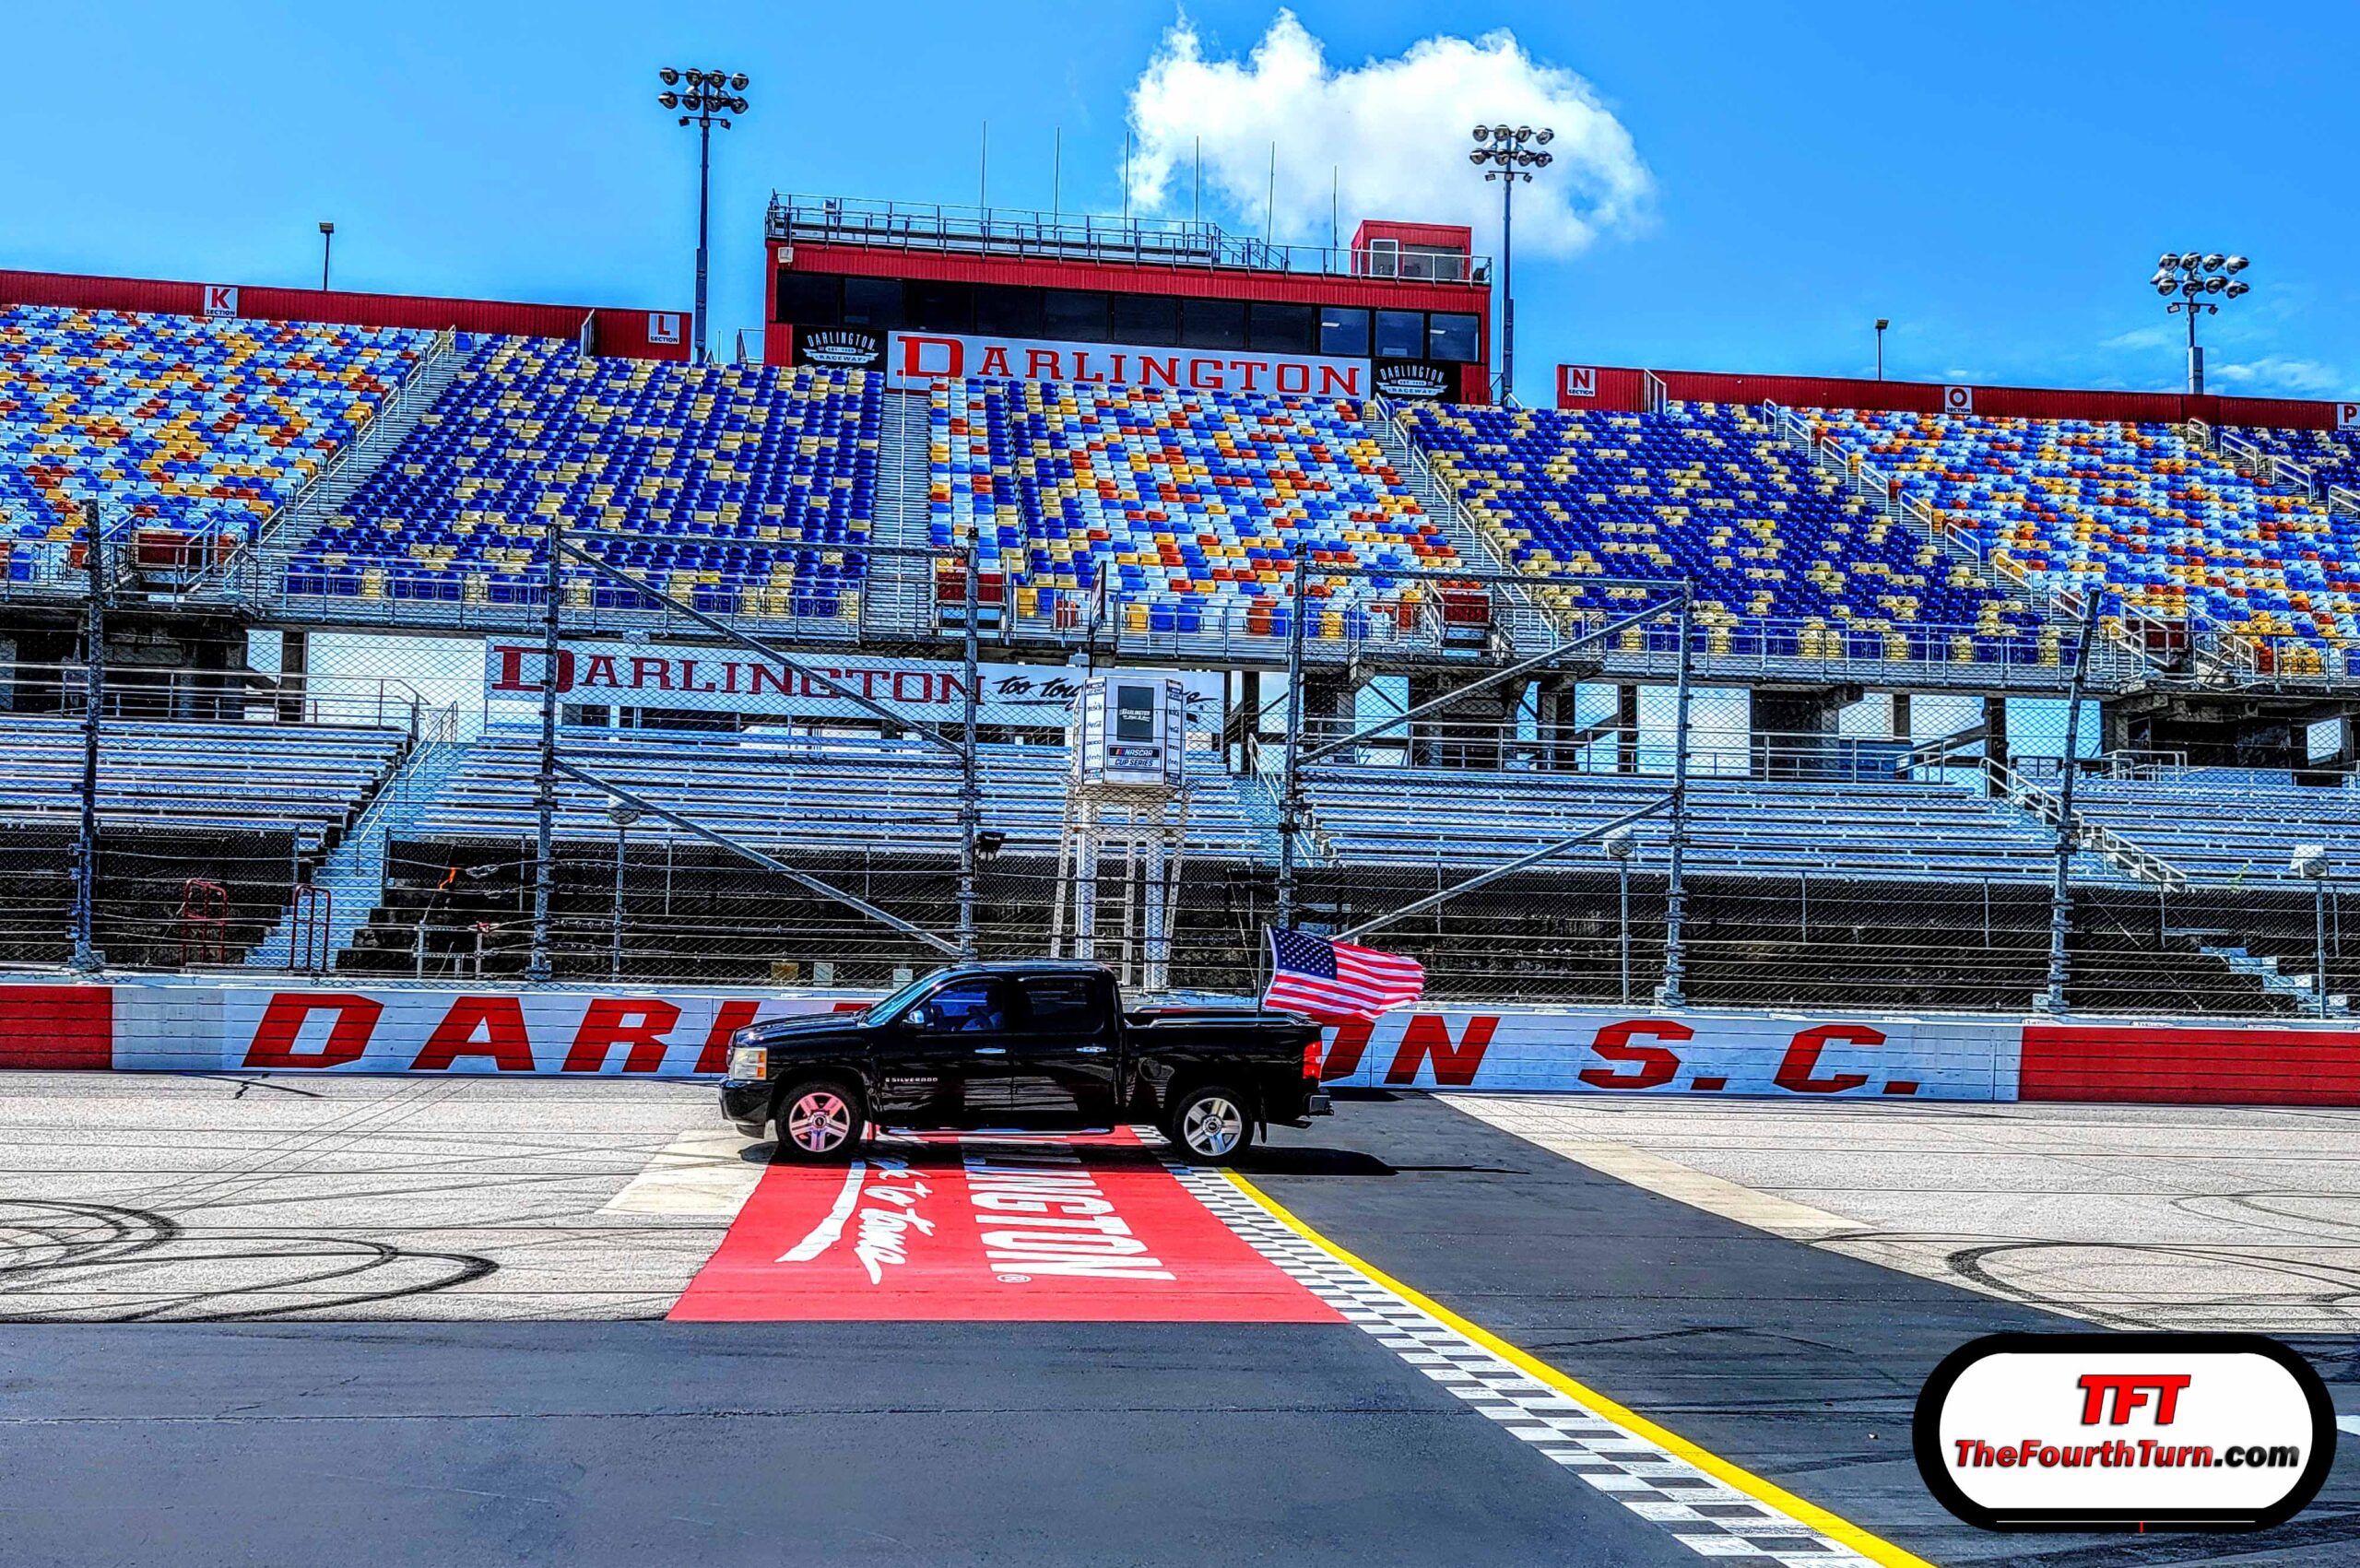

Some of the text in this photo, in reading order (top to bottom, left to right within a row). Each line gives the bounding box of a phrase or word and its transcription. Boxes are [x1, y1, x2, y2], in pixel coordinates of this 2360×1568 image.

[211, 288, 231, 309] K
[657, 314, 671, 336] L
[807, 331, 877, 351] DARLINGTON
[819, 354, 863, 362] RACEWAY
[896, 335, 1361, 396] DARLINGTON
[1379, 365, 1445, 384] DARLINGTON
[1573, 369, 1590, 389] N
[1391, 386, 1433, 395] RACEWAY
[1948, 387, 1968, 407] O
[2343, 405, 2357, 424] P
[490, 645, 986, 706] DARLINGTON
[1124, 749, 1153, 757] NASCAR
[1129, 759, 1153, 767] SERIES
